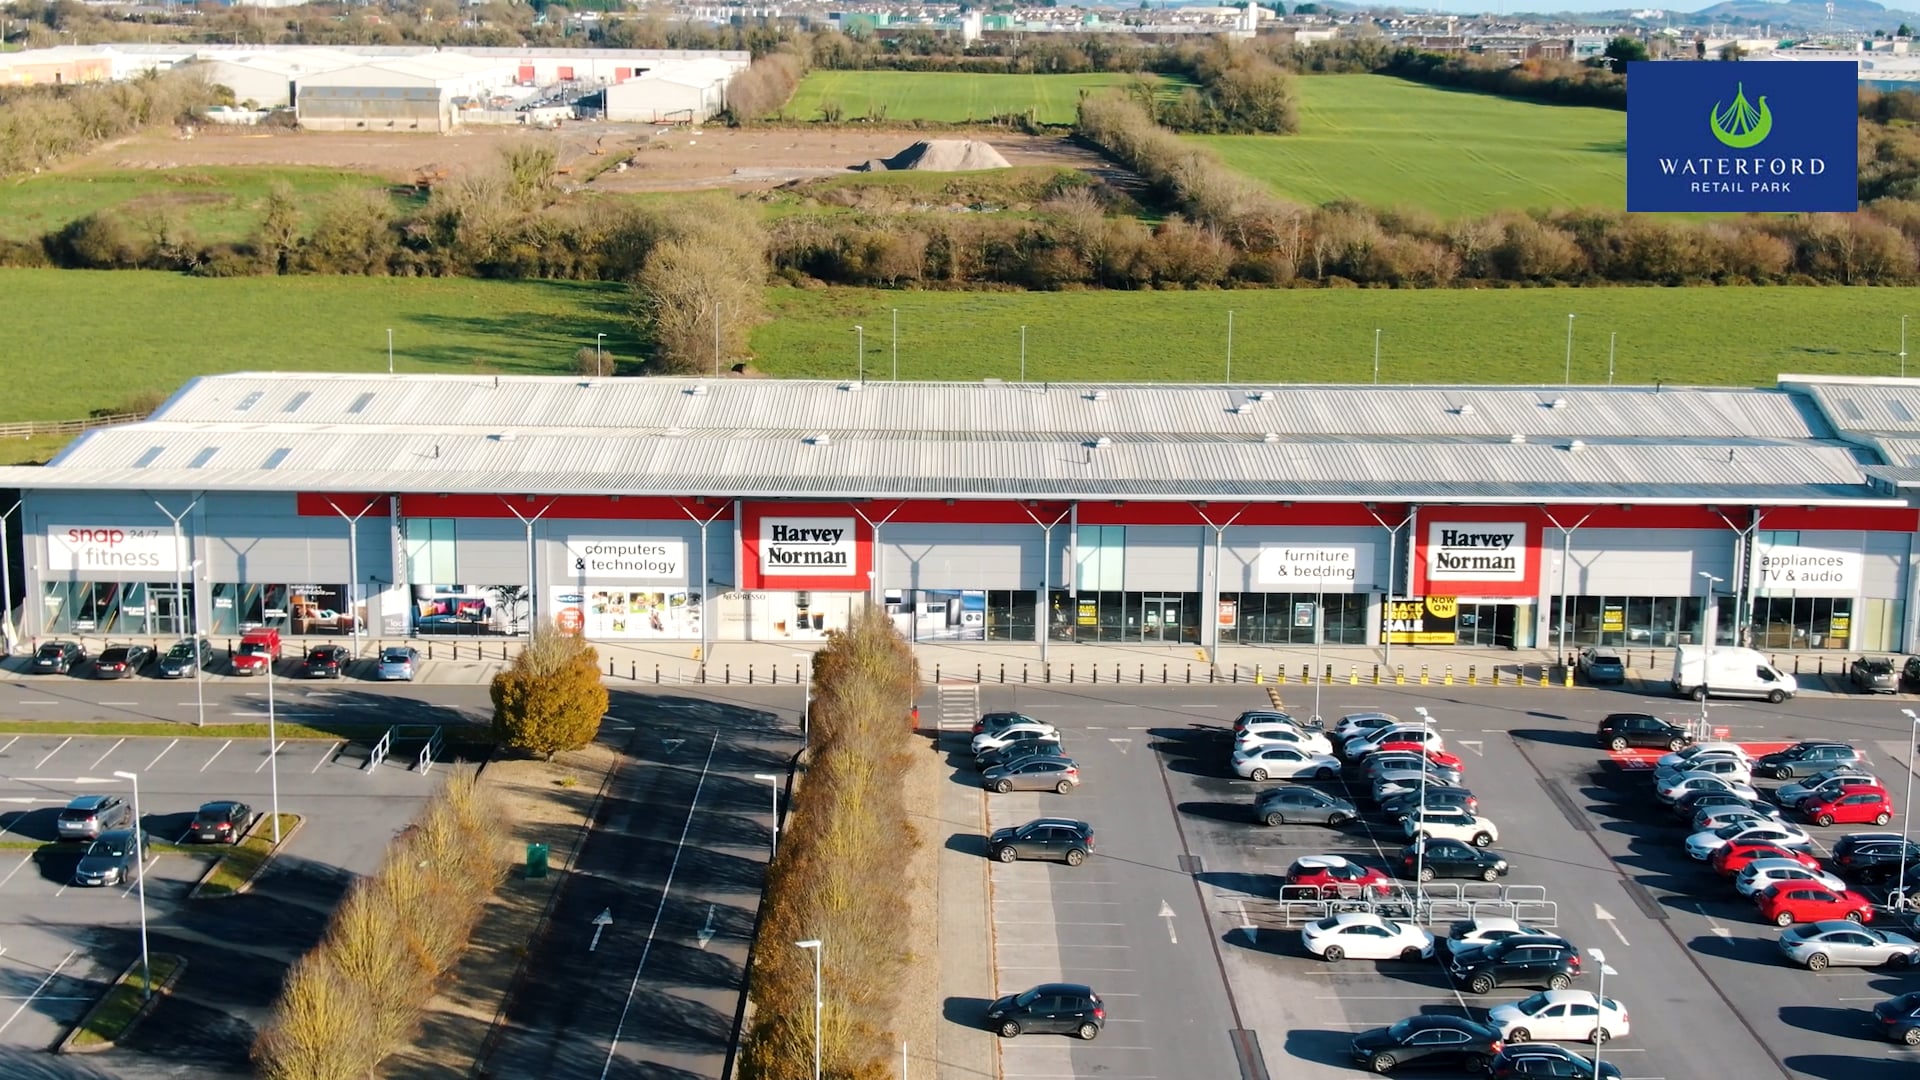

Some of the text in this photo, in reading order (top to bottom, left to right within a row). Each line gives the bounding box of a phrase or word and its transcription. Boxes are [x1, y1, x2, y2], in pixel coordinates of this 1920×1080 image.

[68, 527, 159, 548] snap 24/7
[772, 525, 844, 545] Harvey
[1441, 529, 1514, 551] Harvey
[85, 547, 160, 567] fitness
[585, 543, 667, 557] computers
[768, 547, 847, 564] Norman
[1284, 549, 1350, 562] furniture
[575, 557, 676, 574] & technology
[1436, 552, 1516, 569] Norman
[1762, 554, 1844, 568] appliances
[1278, 564, 1355, 580] & bedding
[1761, 569, 1843, 582] TV & audio
[1432, 596, 1455, 604] NOW
[1434, 604, 1453, 612] ON!
